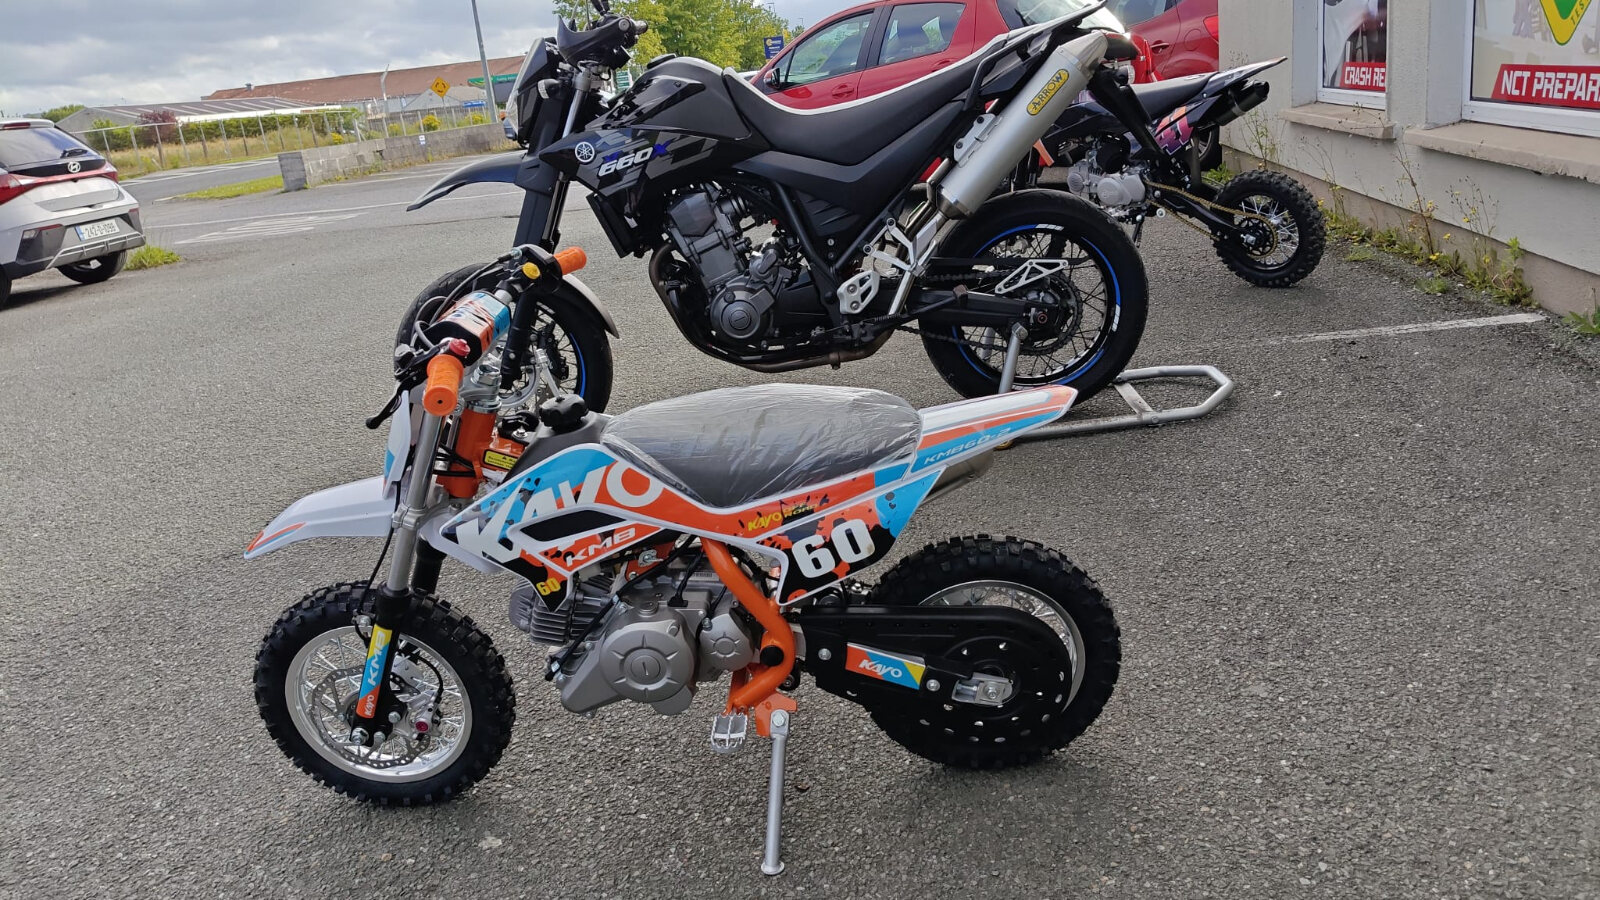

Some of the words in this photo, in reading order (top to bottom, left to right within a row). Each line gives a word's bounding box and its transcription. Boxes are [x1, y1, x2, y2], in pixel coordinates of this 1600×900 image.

[1032, 72, 1063, 110] ARROW
[1344, 66, 1372, 86] CRASH
[1501, 70, 1531, 96] NCT
[455, 459, 665, 563] KAYO
[748, 511, 782, 531] KAYO
[565, 527, 636, 567] KMB
[791, 519, 876, 579] 60
[536, 577, 561, 596] 60
[367, 630, 386, 686] KMB
[859, 659, 903, 678] KAYO
